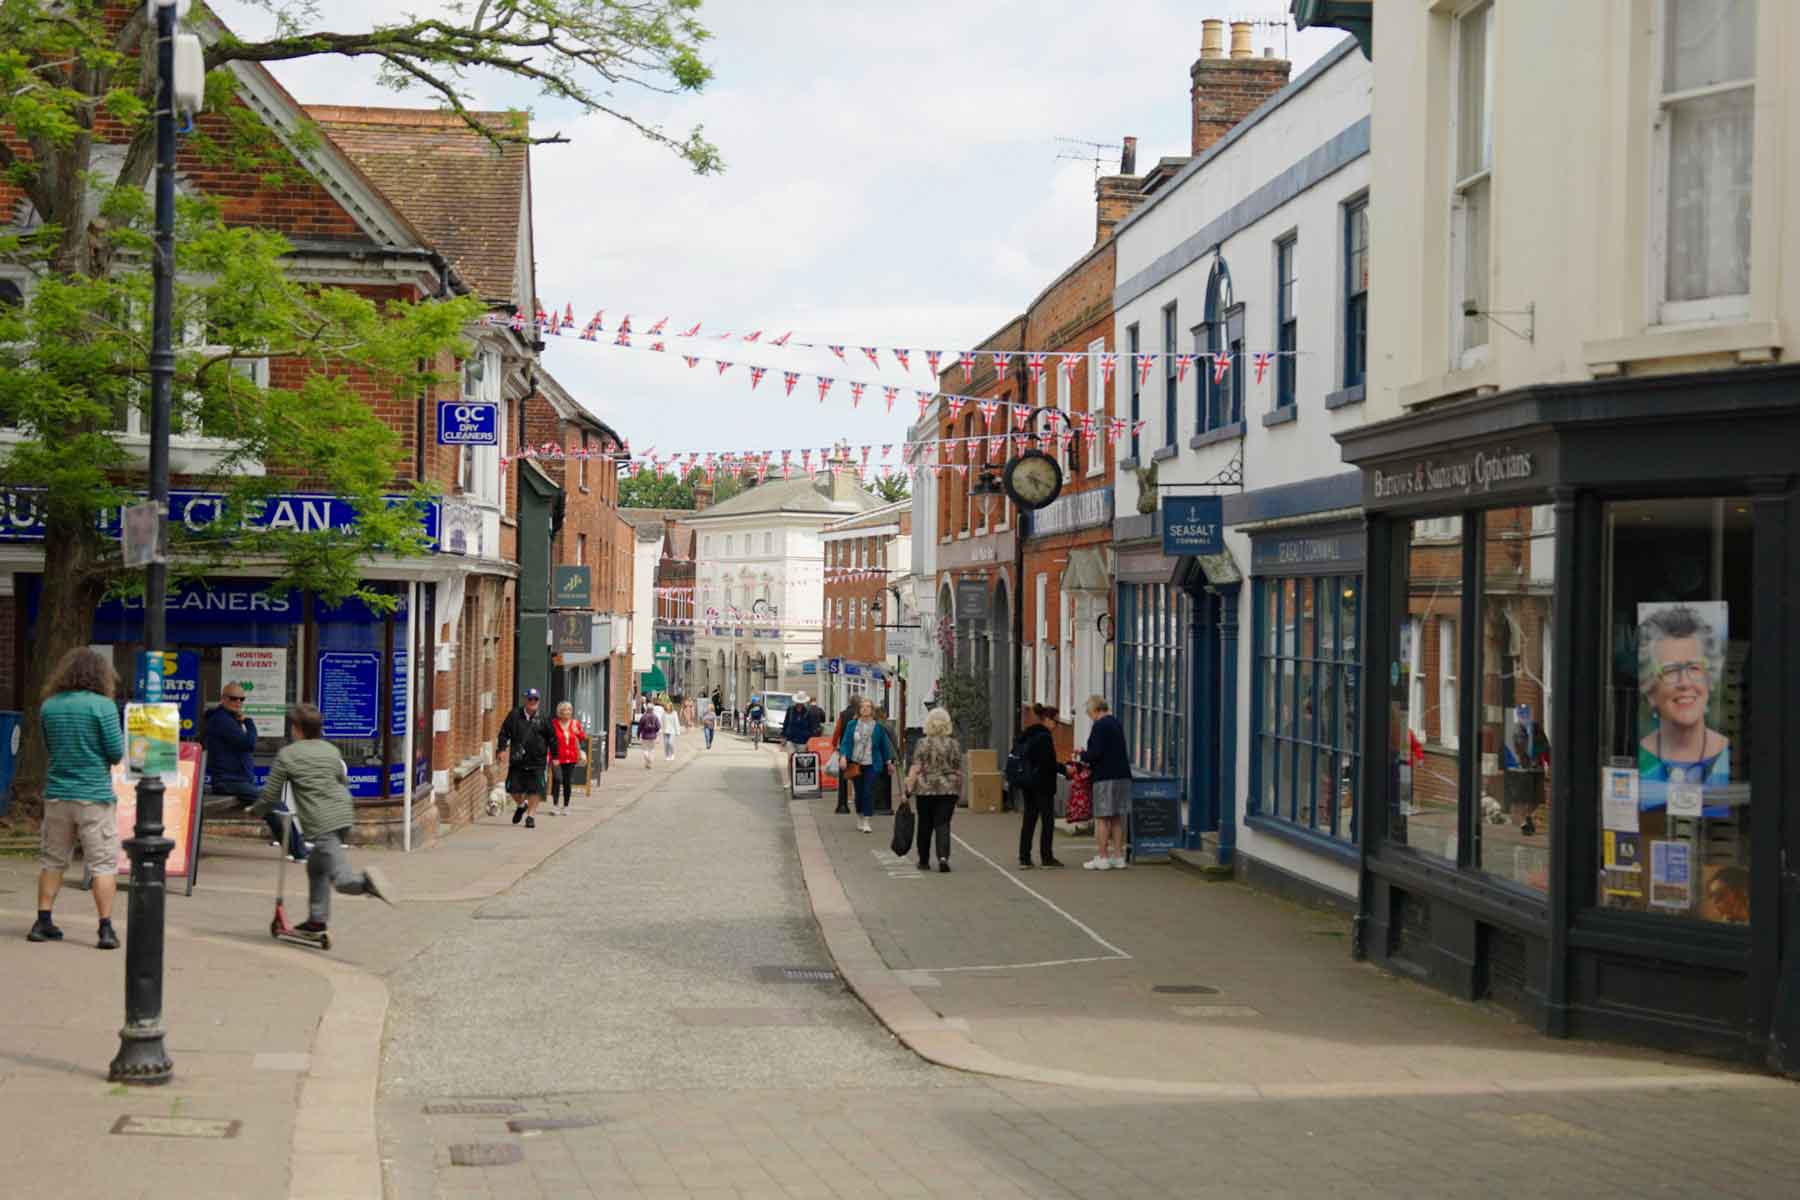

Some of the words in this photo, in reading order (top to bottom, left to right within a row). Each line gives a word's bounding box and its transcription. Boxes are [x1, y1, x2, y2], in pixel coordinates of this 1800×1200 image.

[454, 406, 485, 423] QC
[459, 423, 479, 432] DRY
[445, 431, 493, 440] CLEANERS
[1415, 463, 1425, 492] &
[1475, 446, 1531, 491] Opticians
[1169, 524, 1216, 537] SEASALT
[236, 651, 273, 659] HOSTING
